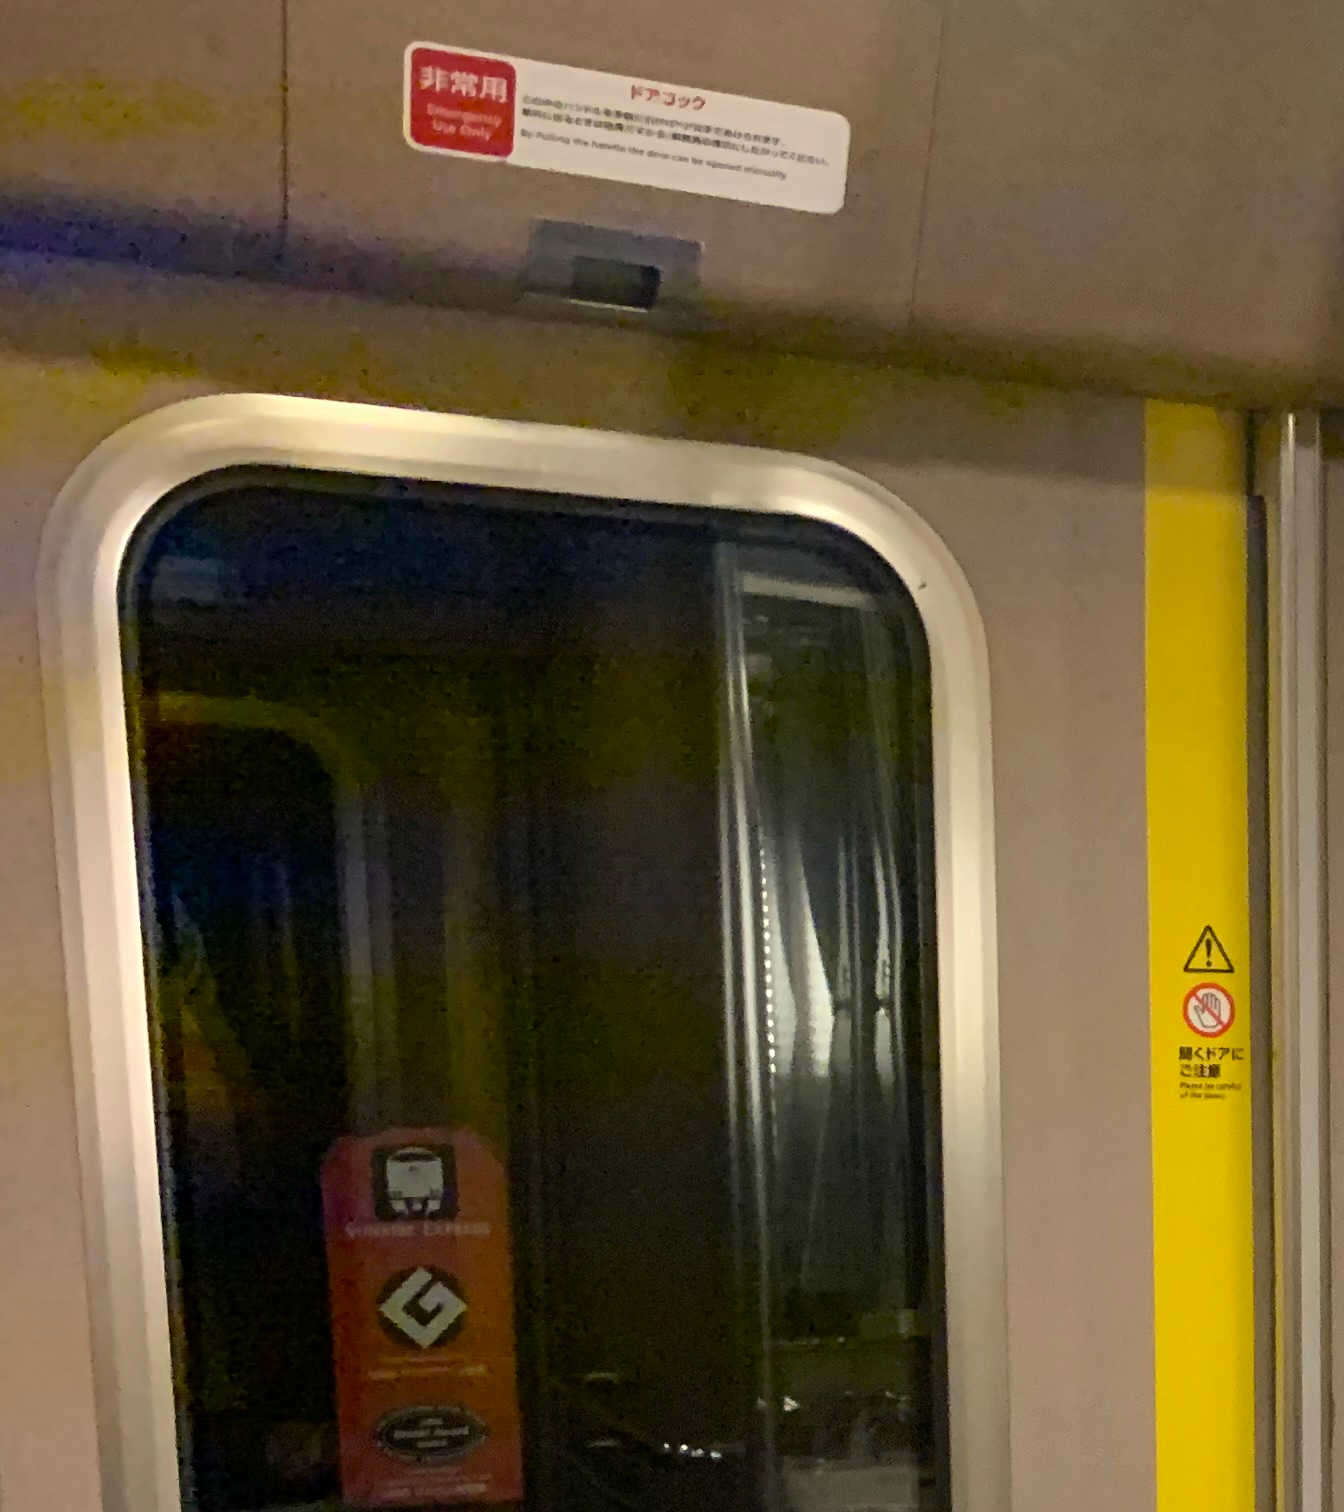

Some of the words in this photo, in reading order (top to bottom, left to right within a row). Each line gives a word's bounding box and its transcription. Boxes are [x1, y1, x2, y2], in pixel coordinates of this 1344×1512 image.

[419, 65, 508, 104] 非常用
[631, 84, 706, 111] ドアコック
[427, 103, 502, 128] Emergency
[433, 119, 457, 134] Use
[460, 124, 492, 141] Only
[1179, 1063, 1221, 1078] ご注意
